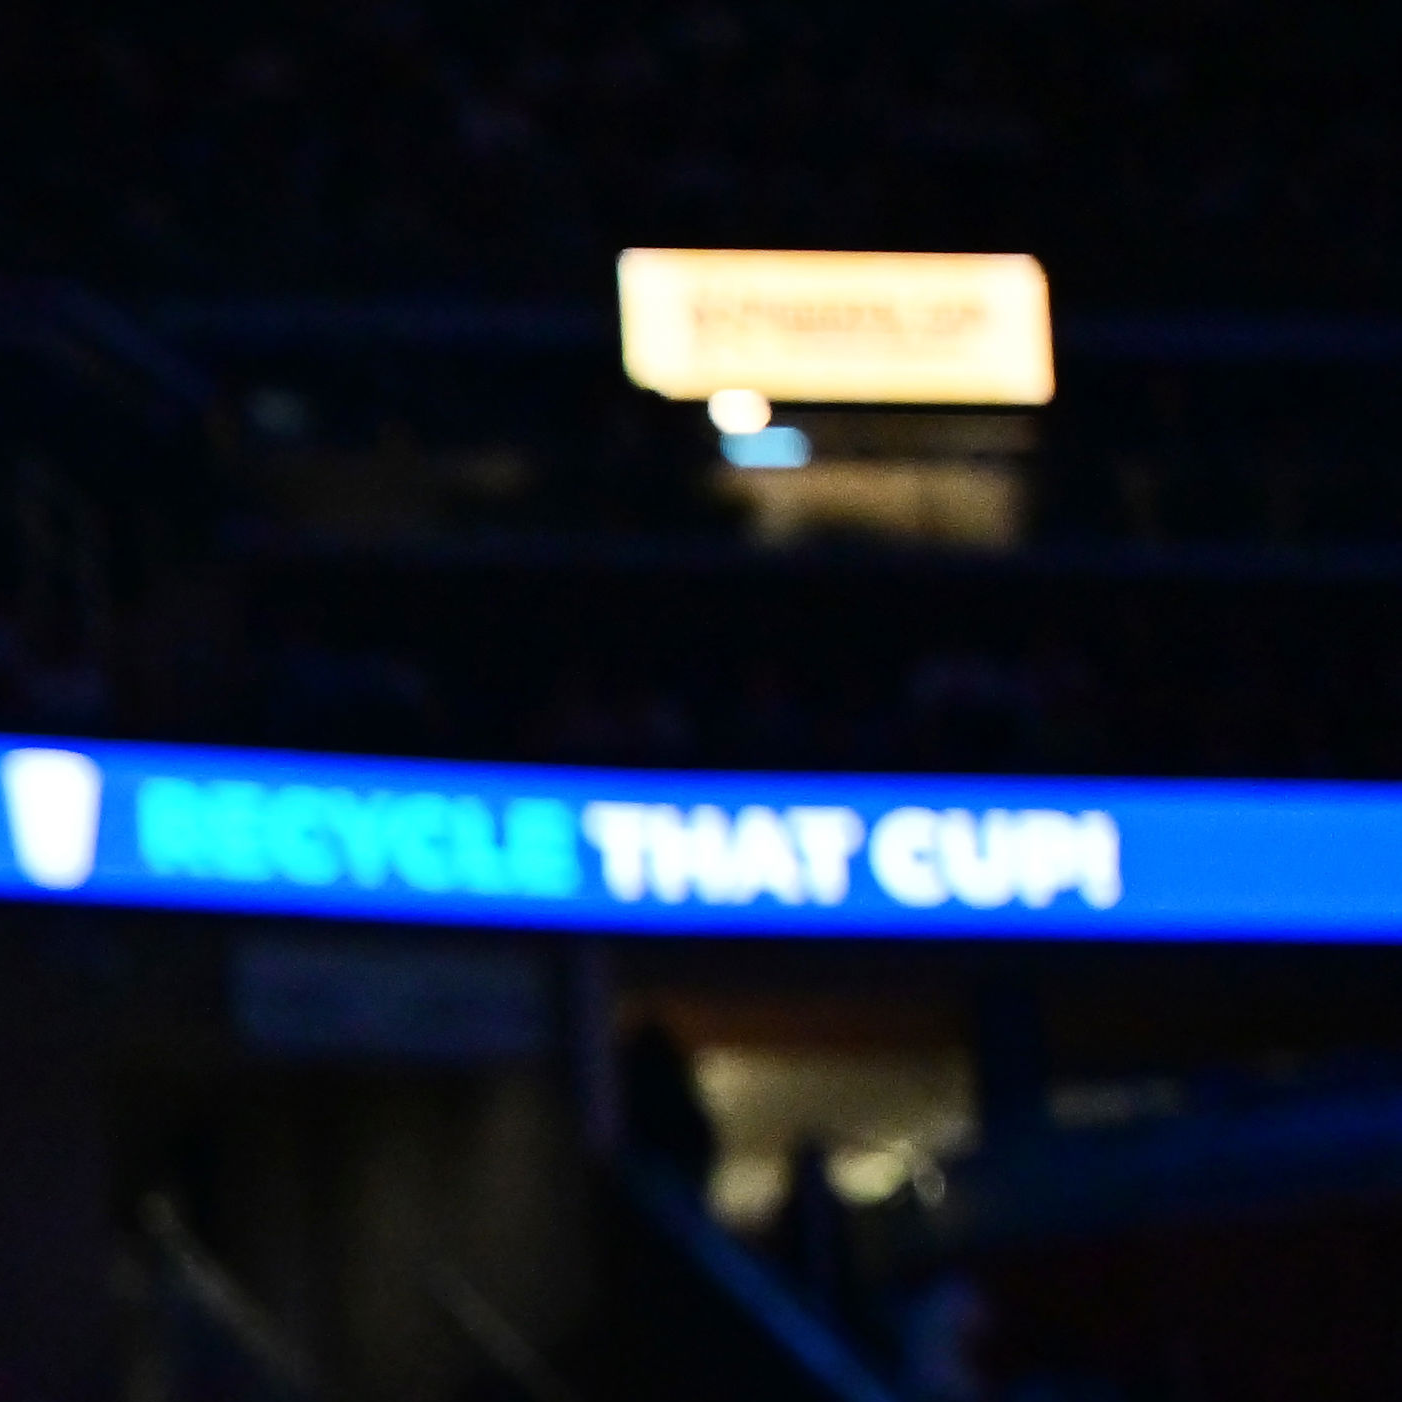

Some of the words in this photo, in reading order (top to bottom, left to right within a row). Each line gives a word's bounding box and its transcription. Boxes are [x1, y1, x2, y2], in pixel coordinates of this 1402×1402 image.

[134, 776, 584, 898] RECYCLE
[584, 801, 863, 905] THAT
[870, 805, 1121, 909] CUP!
